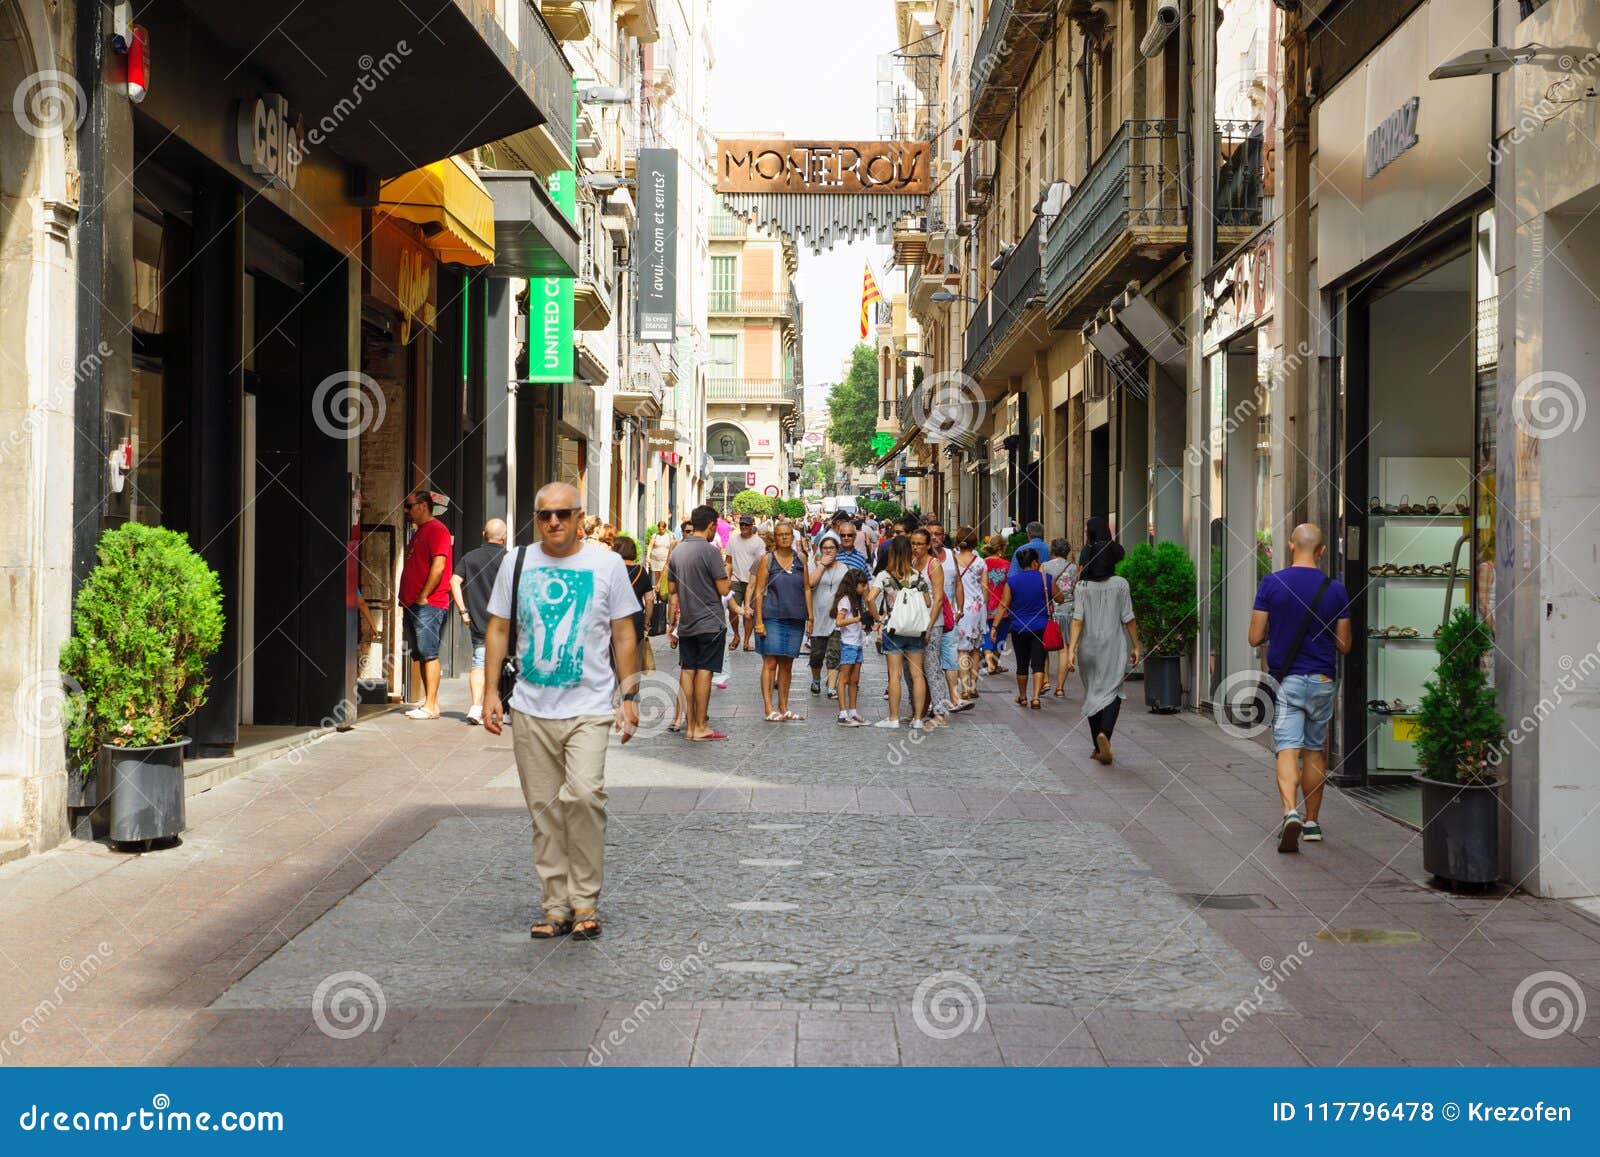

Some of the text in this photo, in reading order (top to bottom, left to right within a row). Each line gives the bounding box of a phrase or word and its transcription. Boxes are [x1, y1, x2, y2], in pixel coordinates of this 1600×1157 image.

[254, 97, 298, 190] celio
[652, 170, 665, 210] sents?
[653, 212, 664, 225] et
[653, 228, 664, 253] com
[544, 301, 560, 369] UNITED
